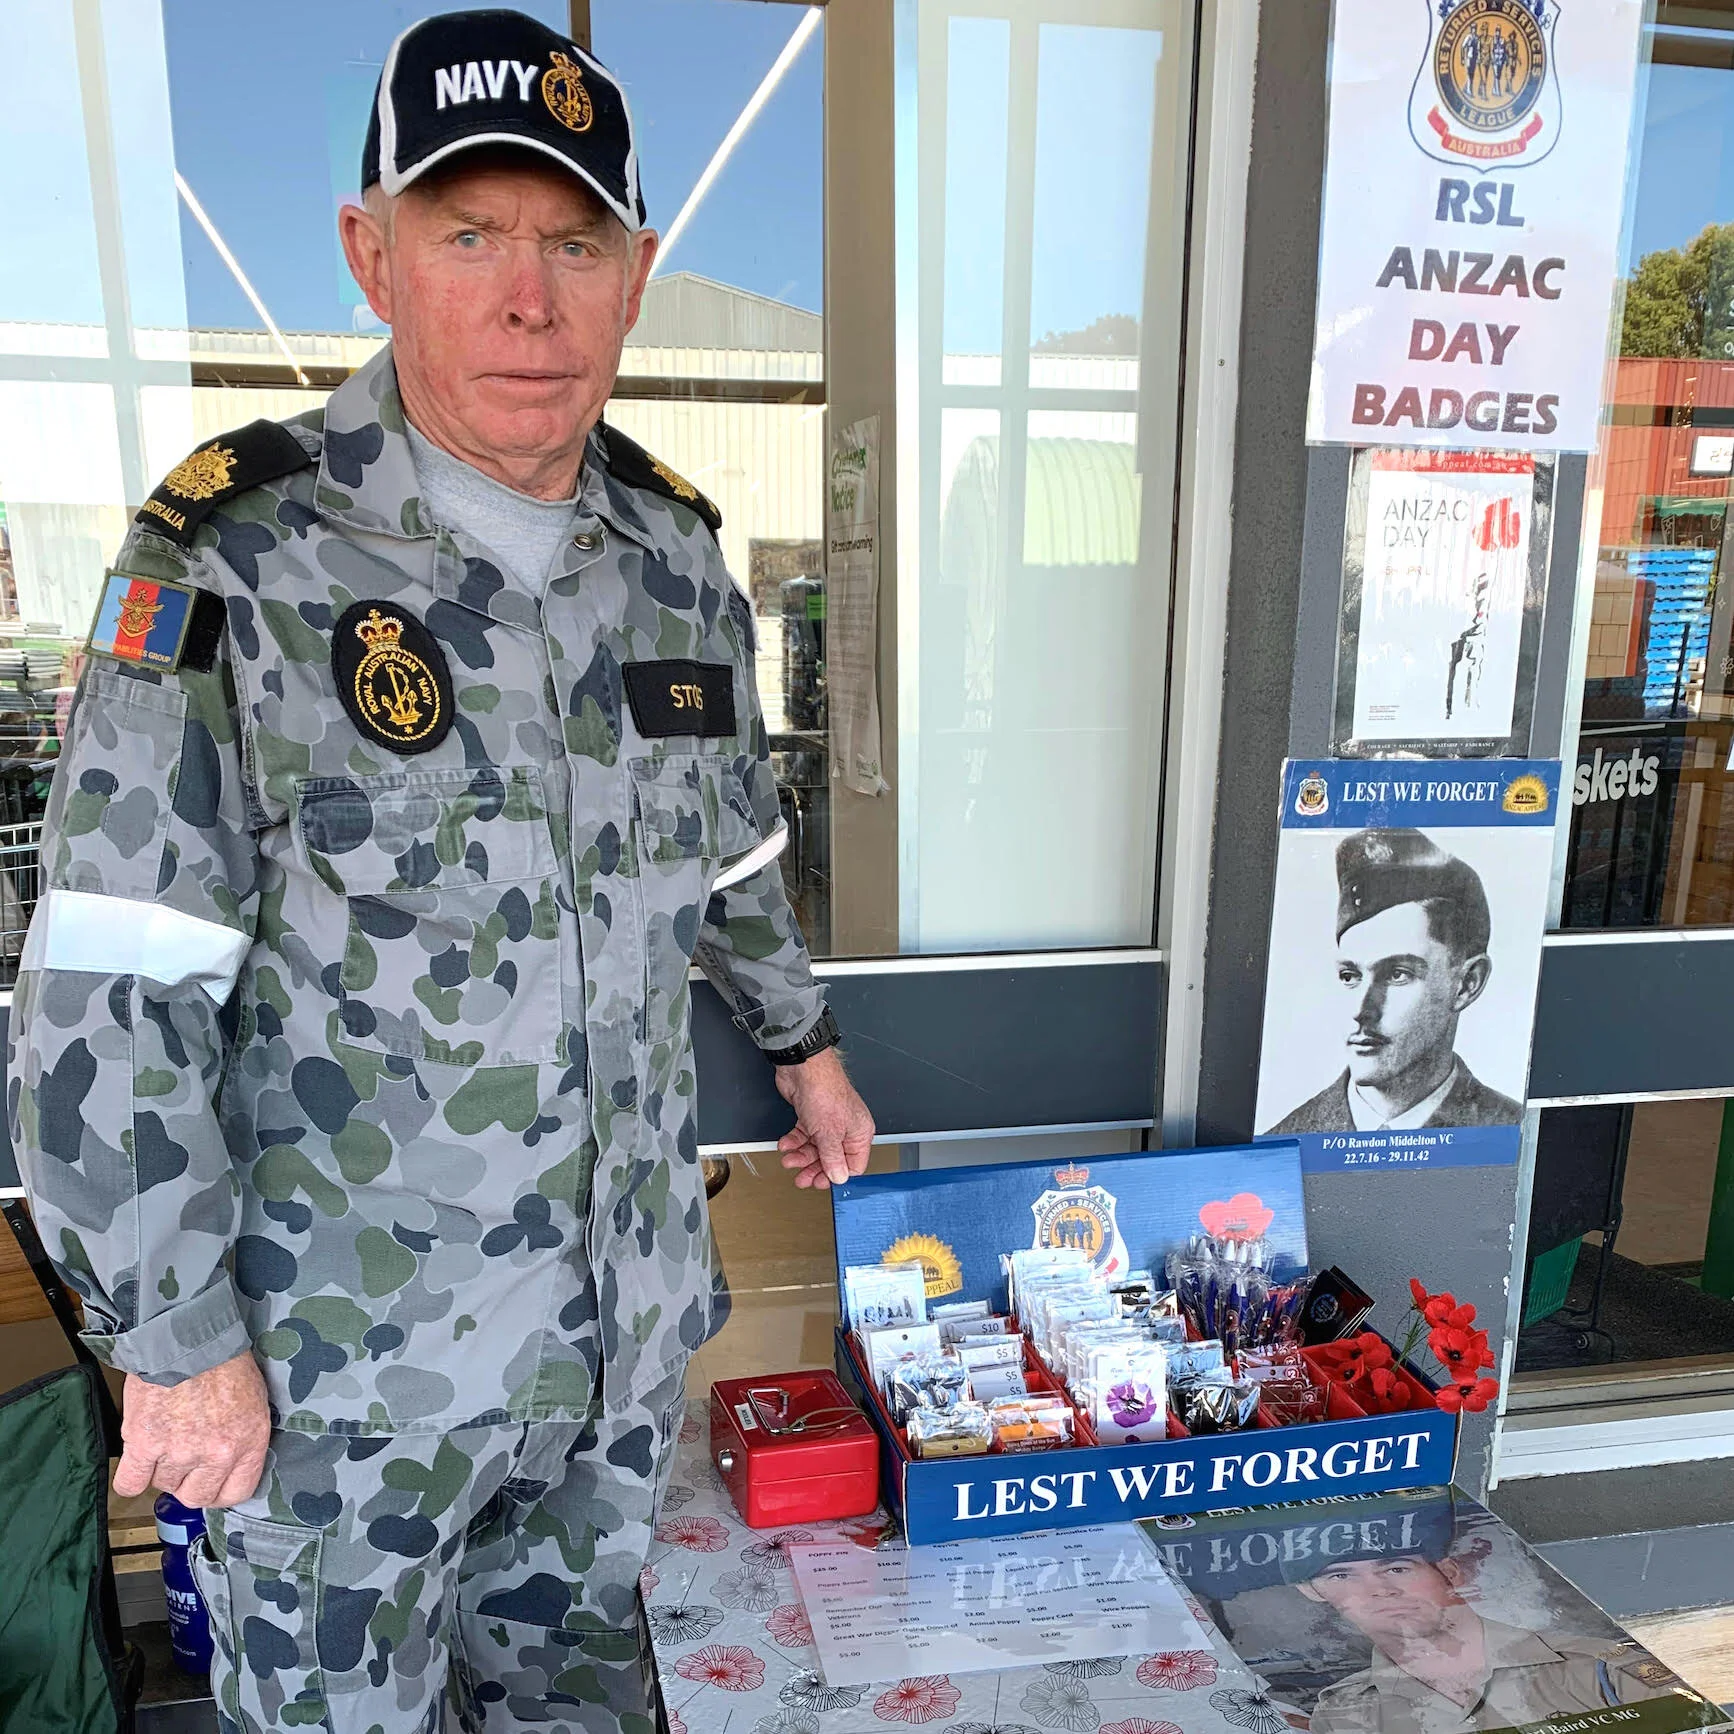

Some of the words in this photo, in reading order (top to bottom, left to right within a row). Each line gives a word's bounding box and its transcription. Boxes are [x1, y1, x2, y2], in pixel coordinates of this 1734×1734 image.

[1439, 1, 1488, 75] RETURNED
[1502, 2, 1542, 76] SERVICES
[434, 60, 539, 111] NAVY
[1459, 105, 1515, 126] LEAGUE
[1448, 139, 1521, 155] AUSTRALIA
[1435, 178, 1525, 227] RSL
[1376, 246, 1566, 299] ANZAC
[1408, 319, 1520, 366] DAY
[1352, 384, 1560, 435] BADGES
[1383, 499, 1469, 521] ANZAC
[1383, 526, 1431, 548] DAY
[148, 651, 171, 663] GROUP
[364, 652, 419, 680] AUSTRALIAN
[363, 682, 381, 715] ROYAL
[417, 677, 433, 706] NAVY
[1573, 747, 1660, 806] skets
[1343, 781, 1390, 802] LEST
[1393, 781, 1422, 802] WE
[1428, 781, 1499, 802] FORGET
[1322, 1136, 1346, 1150] P/O
[1348, 1136, 1387, 1149] Rawdon
[1389, 1135, 1436, 1147] Middelton
[1439, 1133, 1454, 1145] VC
[1344, 1152, 1380, 1164] 22.7.16
[1388, 1150, 1429, 1163] 29.11.42
[1042, 1202, 1069, 1242] RETURNED
[1077, 1199, 1111, 1233] SERVICES
[925, 1279, 959, 1296] PPEAL
[981, 1322, 999, 1334] $10
[996, 1348, 1008, 1359] $5
[1005, 1371, 1018, 1382] $5
[1010, 1387, 1022, 1396] $5
[952, 1470, 1096, 1522] LEST
[1108, 1460, 1195, 1501] WE
[1210, 1431, 1430, 1493] FORGET
[1547, 1719, 1590, 1734] Baird
[1587, 1713, 1614, 1726] VC
[1611, 1708, 1641, 1722] MG
